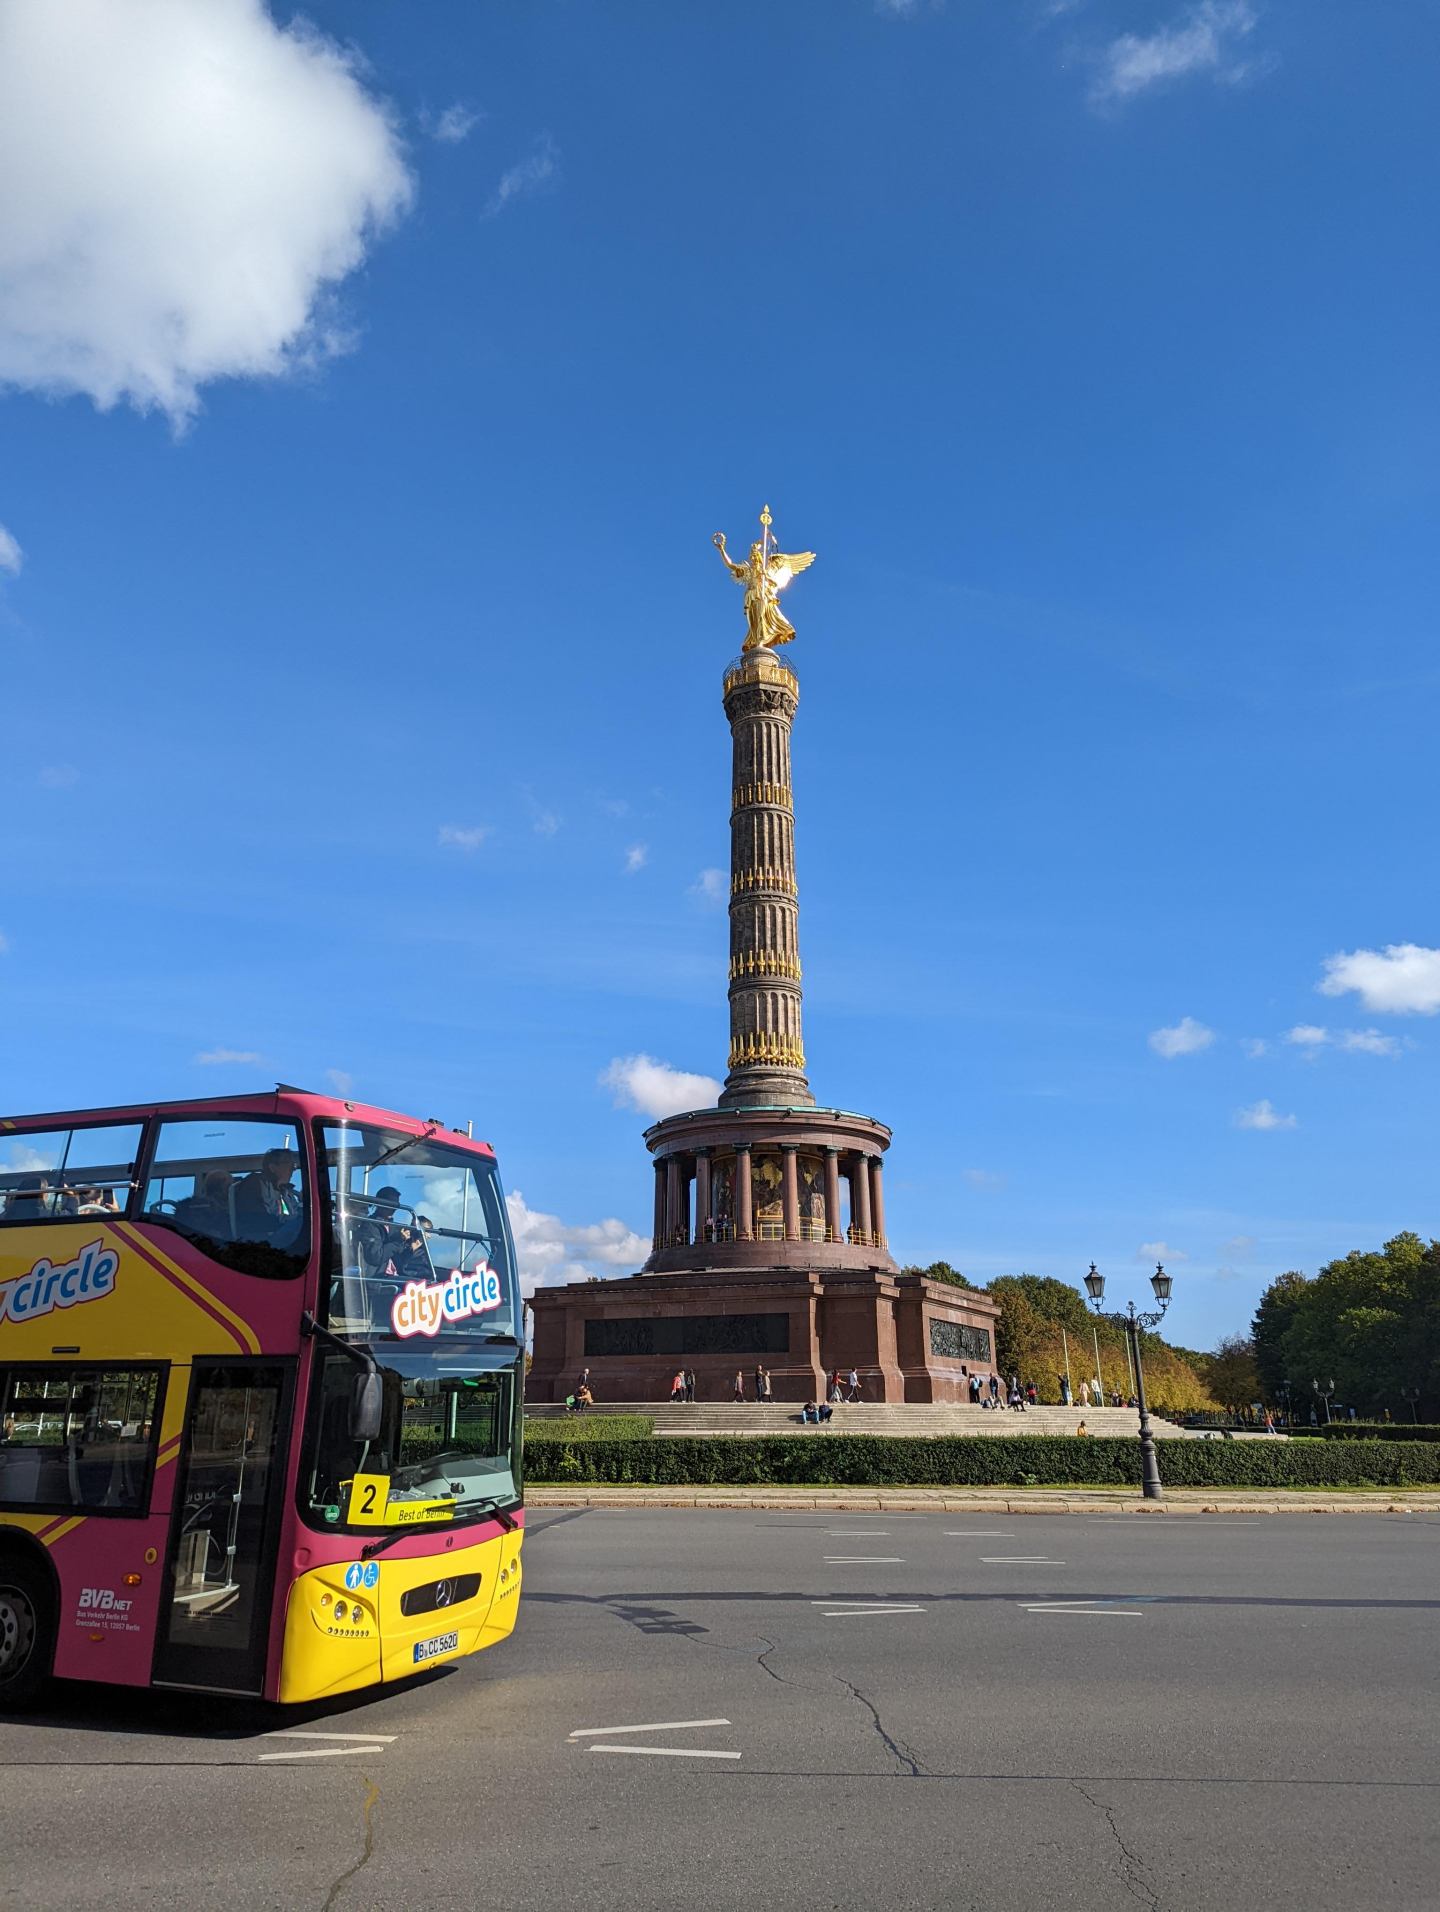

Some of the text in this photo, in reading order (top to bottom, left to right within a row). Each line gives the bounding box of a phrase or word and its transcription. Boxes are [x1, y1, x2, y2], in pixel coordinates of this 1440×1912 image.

[360, 1484, 377, 1514] 2
[399, 1510, 416, 1521] Best
[417, 1508, 426, 1519] of
[105, 1612, 120, 1620] Berlin
[126, 1624, 140, 1632] Berlin
[419, 1644, 424, 1658] B
[439, 1633, 457, 1651] 5620
